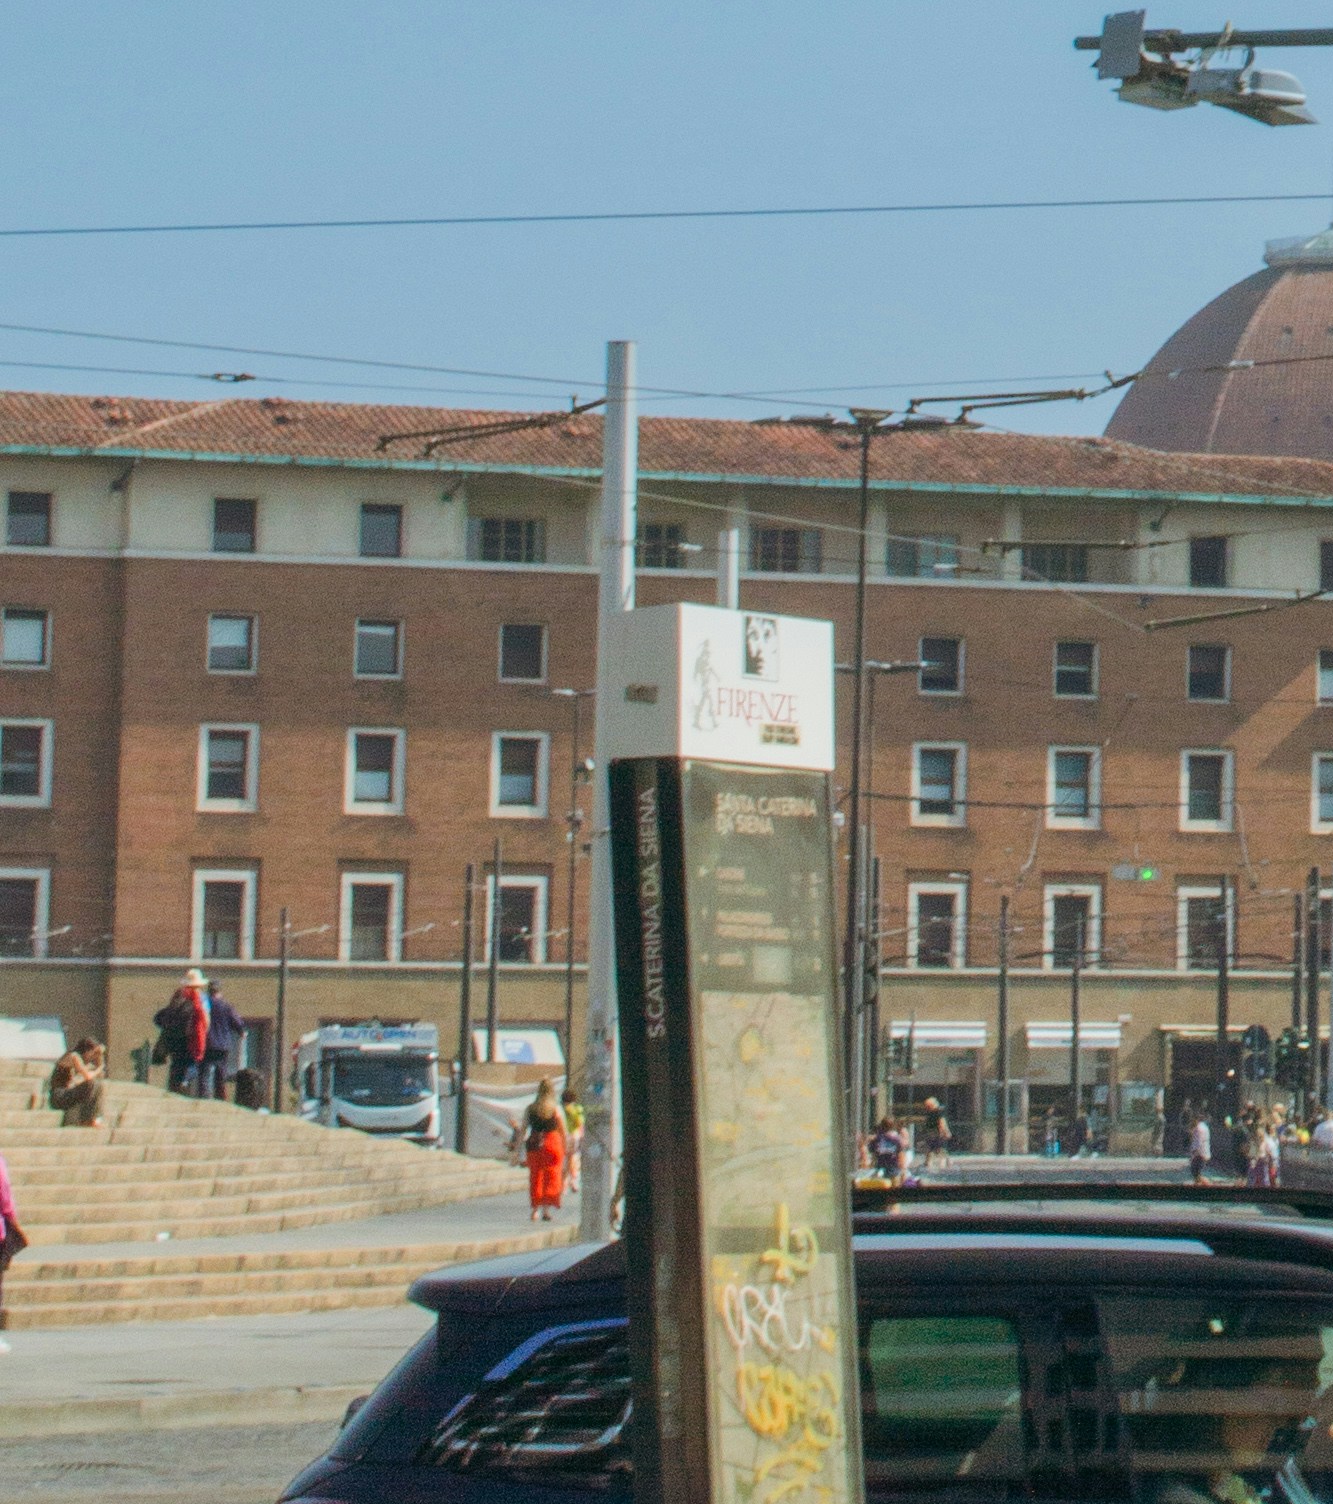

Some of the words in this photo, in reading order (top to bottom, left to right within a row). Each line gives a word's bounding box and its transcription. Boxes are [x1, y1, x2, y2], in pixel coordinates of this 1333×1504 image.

[717, 687, 799, 726] FIRENZE
[638, 787, 659, 857] SIENA
[735, 813, 774, 836] SIENA
[758, 796, 817, 817] CATERINA
[640, 862, 662, 898] DA
[641, 903, 667, 1038] S.CATERINA
